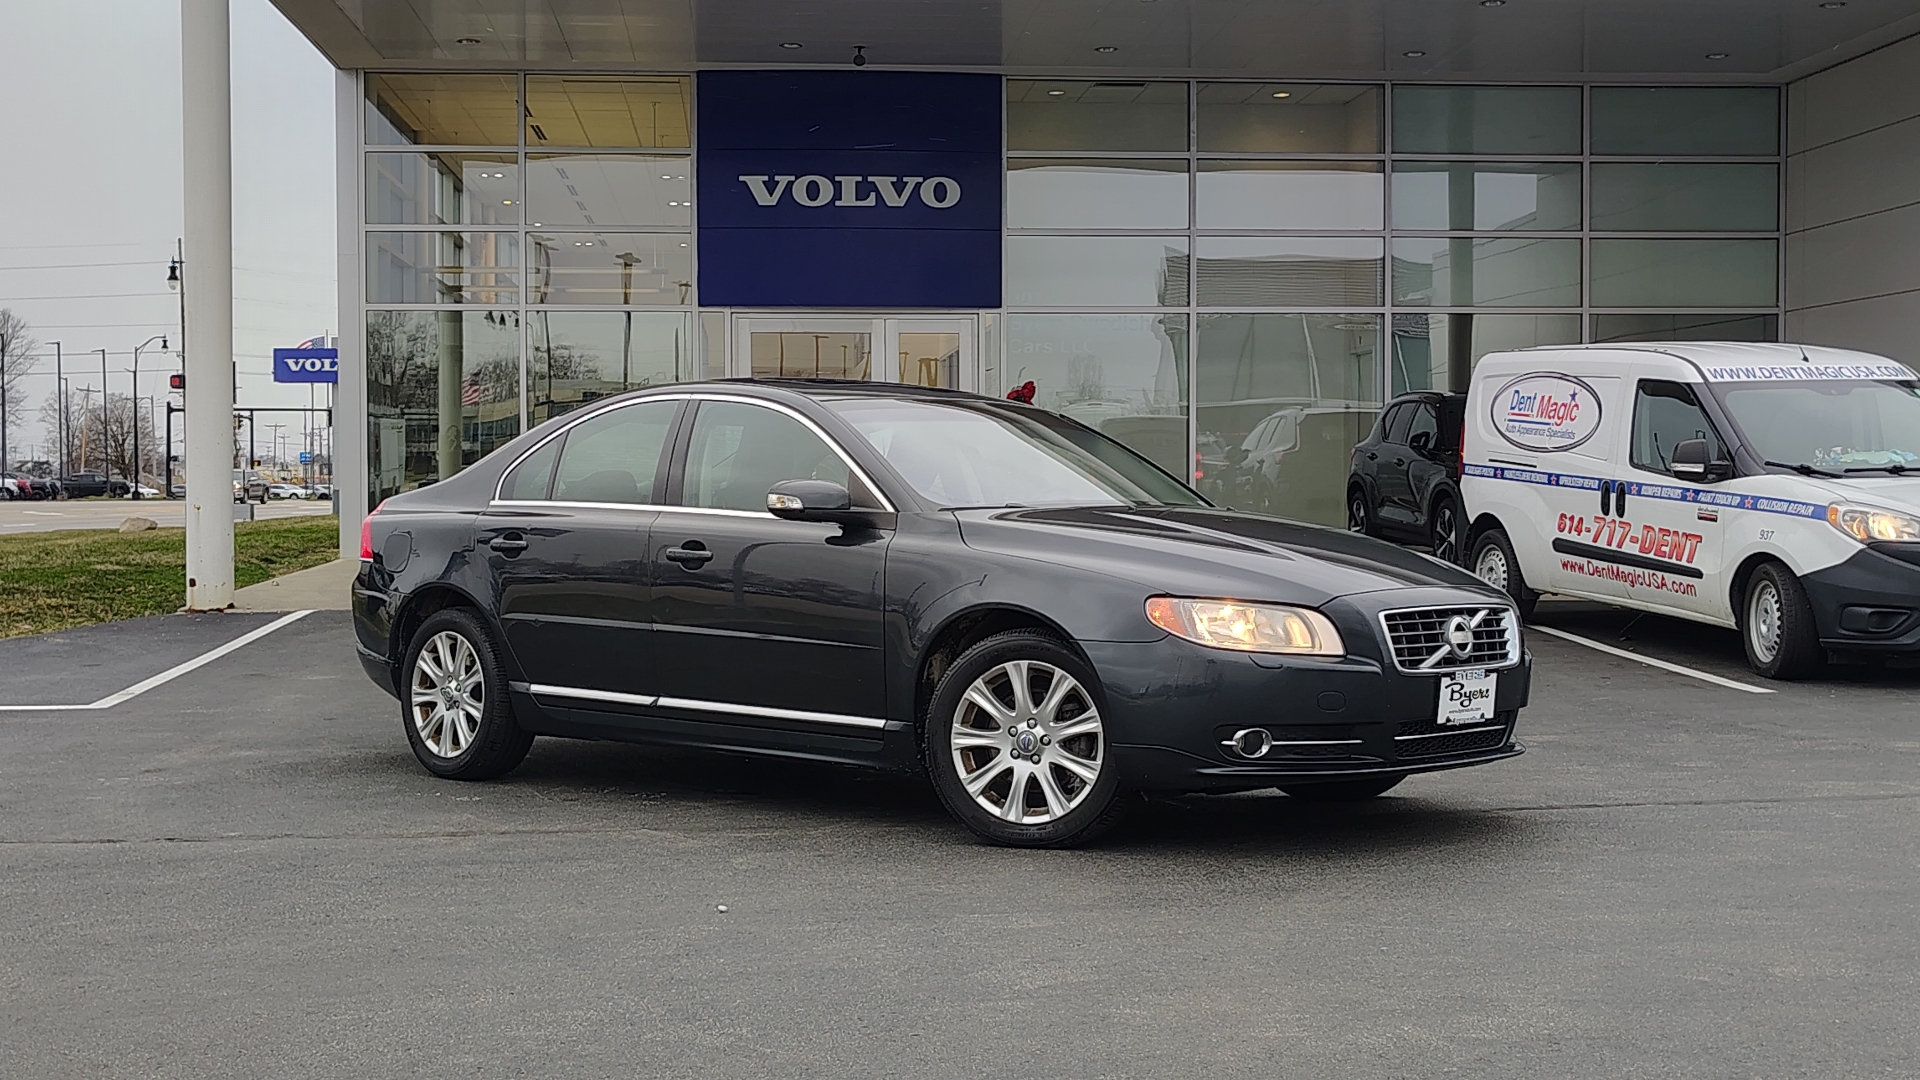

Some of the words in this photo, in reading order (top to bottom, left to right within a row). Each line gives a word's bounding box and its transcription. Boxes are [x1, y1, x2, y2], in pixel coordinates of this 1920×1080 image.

[738, 174, 962, 209] VOLVO
[1010, 338, 1053, 354] Cars
[284, 358, 338, 372] VOL
[1706, 364, 1909, 381] WWW.DENTMAGICUSA.COM
[1509, 389, 1537, 414] Dent
[1535, 394, 1579, 427] Magic
[1505, 424, 1517, 434] Auto
[1516, 425, 1546, 438] Appearance
[1546, 427, 1576, 441] Specialists
[1697, 491, 1715, 503] PAINT
[1713, 493, 1732, 505] TOUCH
[1731, 495, 1740, 507] UP
[1756, 498, 1789, 512] COLLISION
[1788, 503, 1814, 516] REPAIR
[1556, 512, 1703, 564] 614-717-DENT
[1758, 529, 1775, 541] 937
[1560, 559, 1698, 597] www.DentMagicUSA.com
[1445, 683, 1490, 707] Byers
